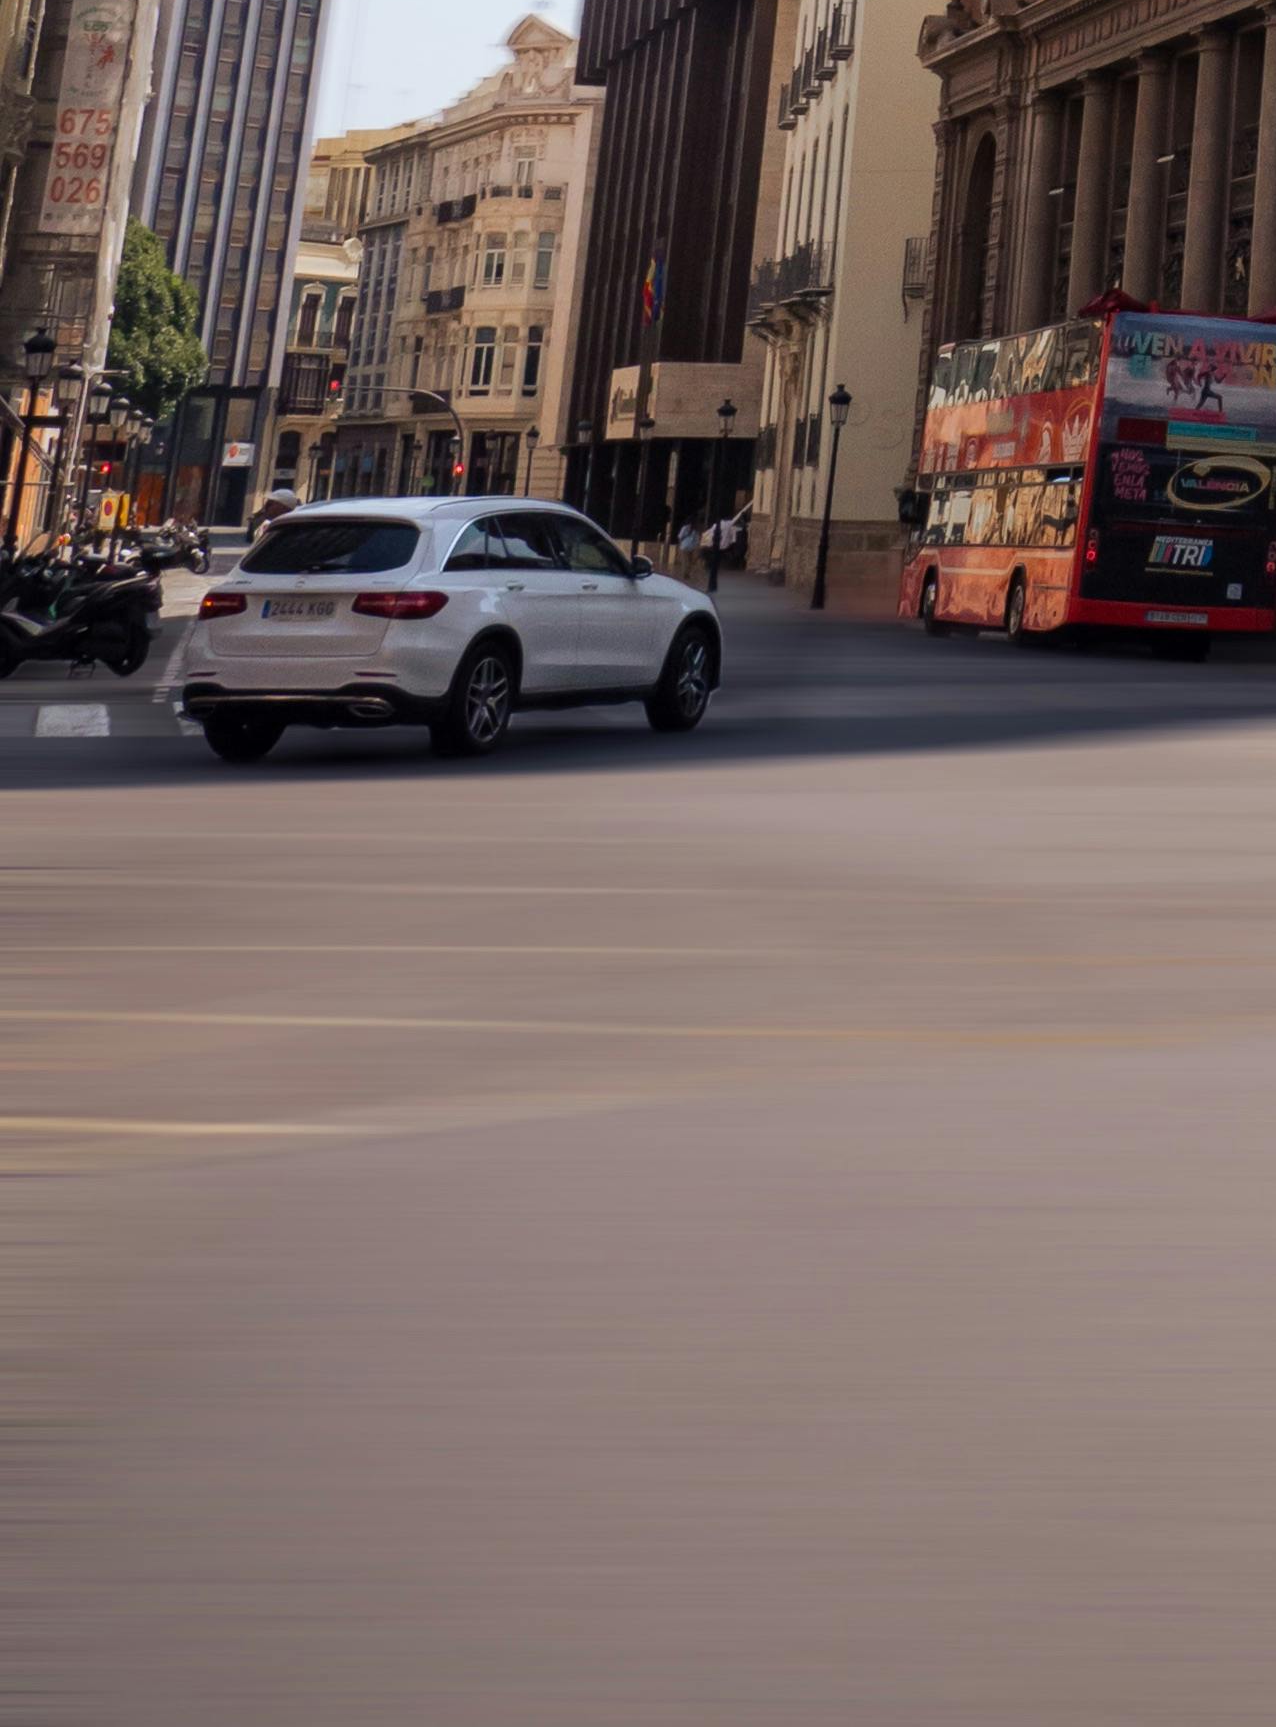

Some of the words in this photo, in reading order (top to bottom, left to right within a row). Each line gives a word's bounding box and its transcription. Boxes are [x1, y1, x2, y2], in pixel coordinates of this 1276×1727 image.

[59, 107, 112, 136] 675
[55, 143, 107, 170] 569
[50, 175, 101, 204] 026
[1172, 544, 1207, 567] TRI
